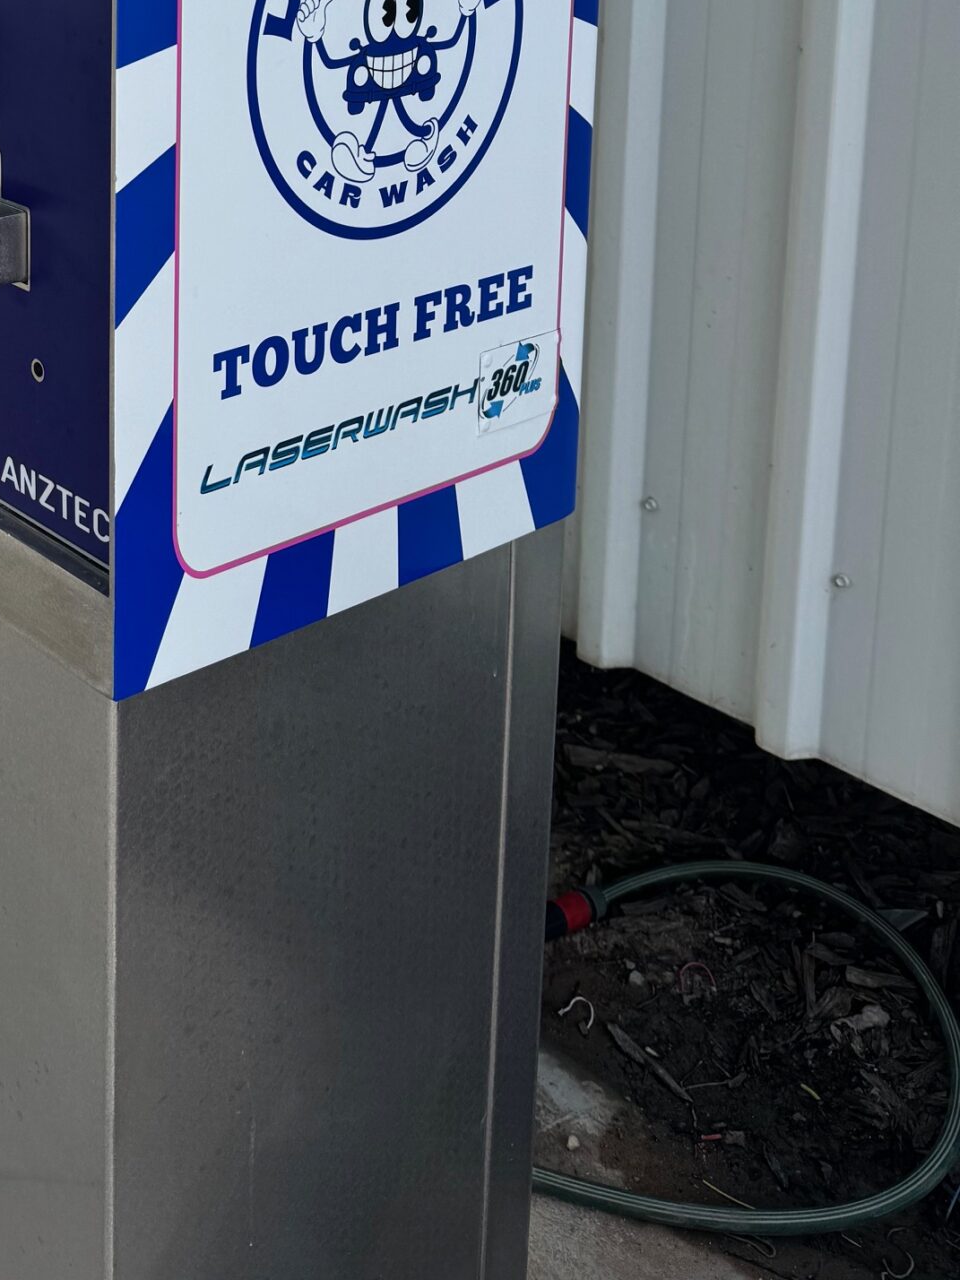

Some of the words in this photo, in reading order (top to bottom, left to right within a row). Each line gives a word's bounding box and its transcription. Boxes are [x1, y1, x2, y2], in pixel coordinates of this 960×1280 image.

[295, 149, 363, 209] CAR
[378, 113, 479, 209] WASH
[212, 301, 401, 401] TOUCH
[413, 264, 534, 342] FREE
[199, 378, 481, 495] LASERWASH
[487, 360, 530, 403] 360
[519, 377, 542, 397] PLUS
[0, 456, 110, 544] ANZTEC
